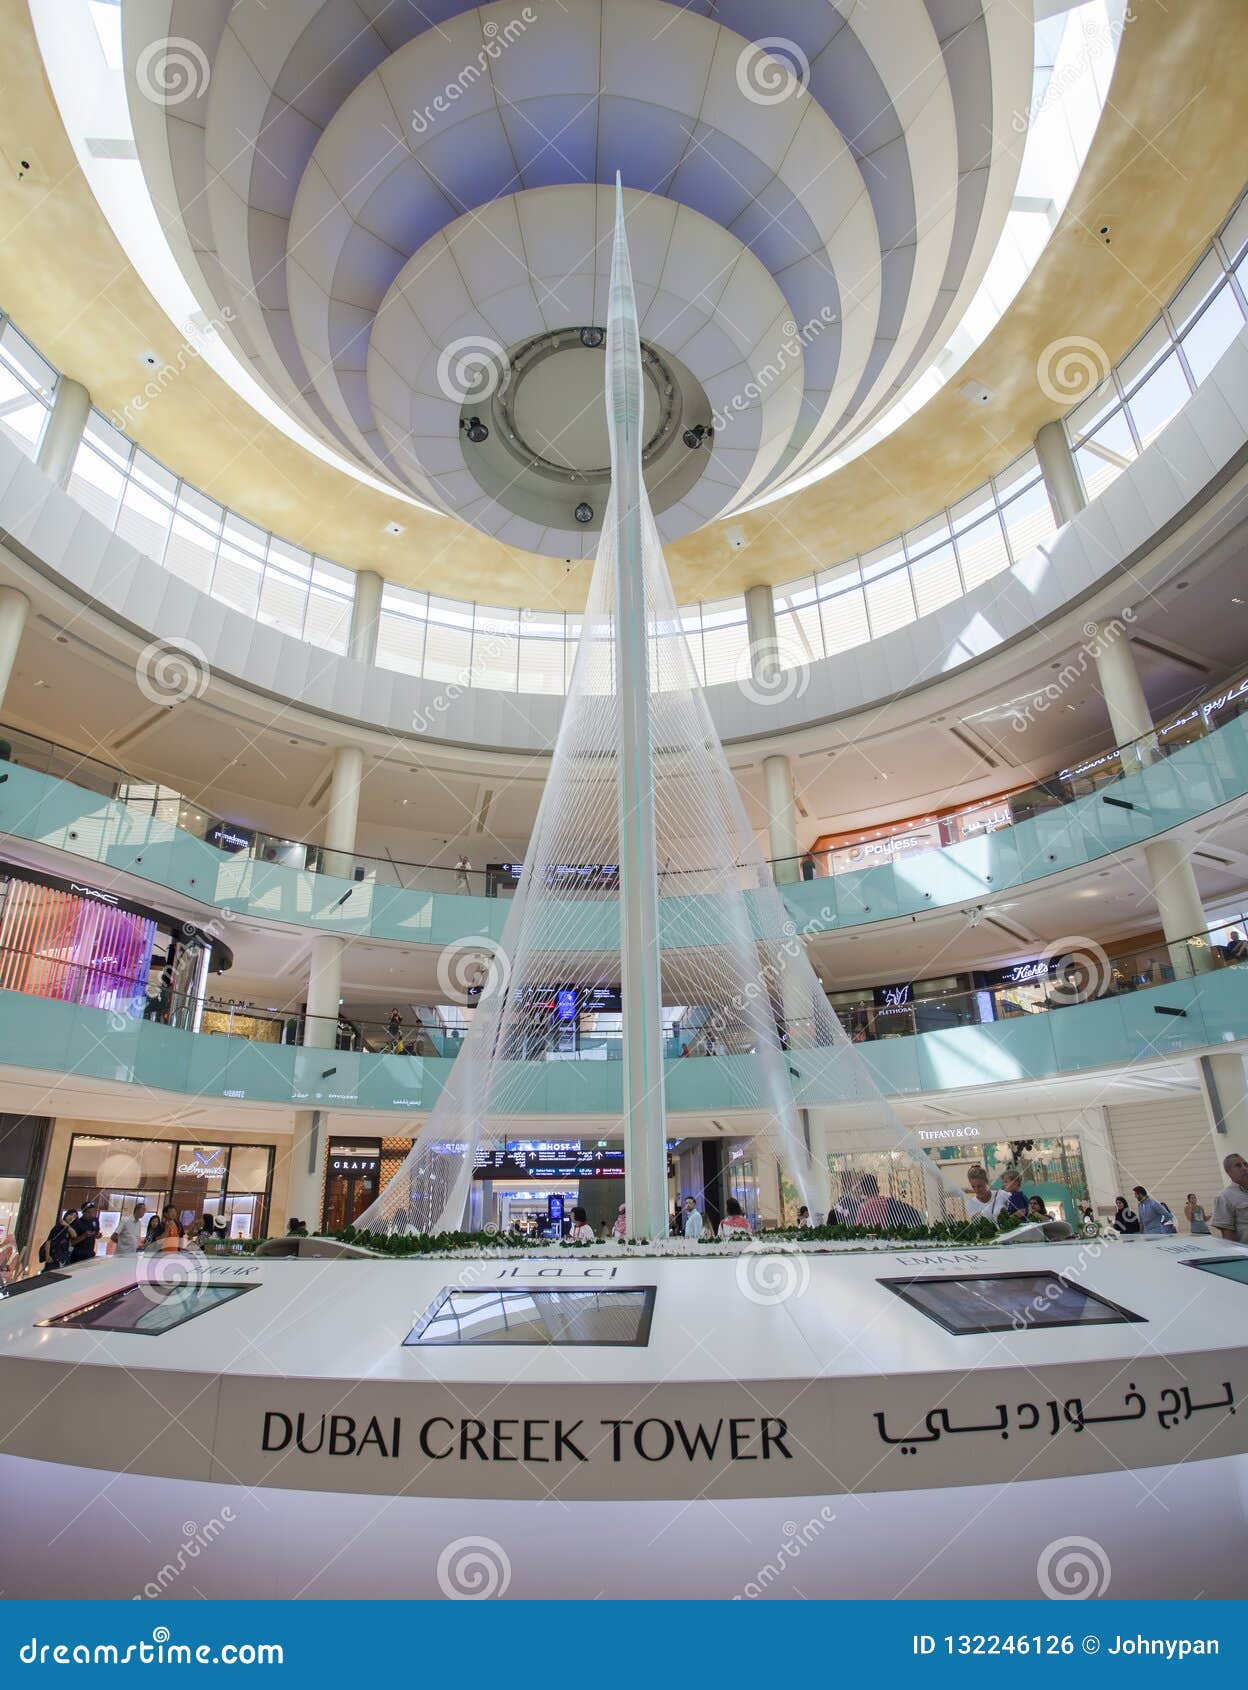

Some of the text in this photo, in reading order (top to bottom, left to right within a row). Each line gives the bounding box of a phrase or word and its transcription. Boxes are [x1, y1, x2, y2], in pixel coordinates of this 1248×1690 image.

[864, 837, 918, 855] Payless
[1012, 962, 1049, 981] Kiehl's
[918, 1129, 956, 1140] TIFFANY
[333, 1161, 376, 1170] GRAFF
[262, 1411, 794, 1463] DUBAI CREEK TOWER
